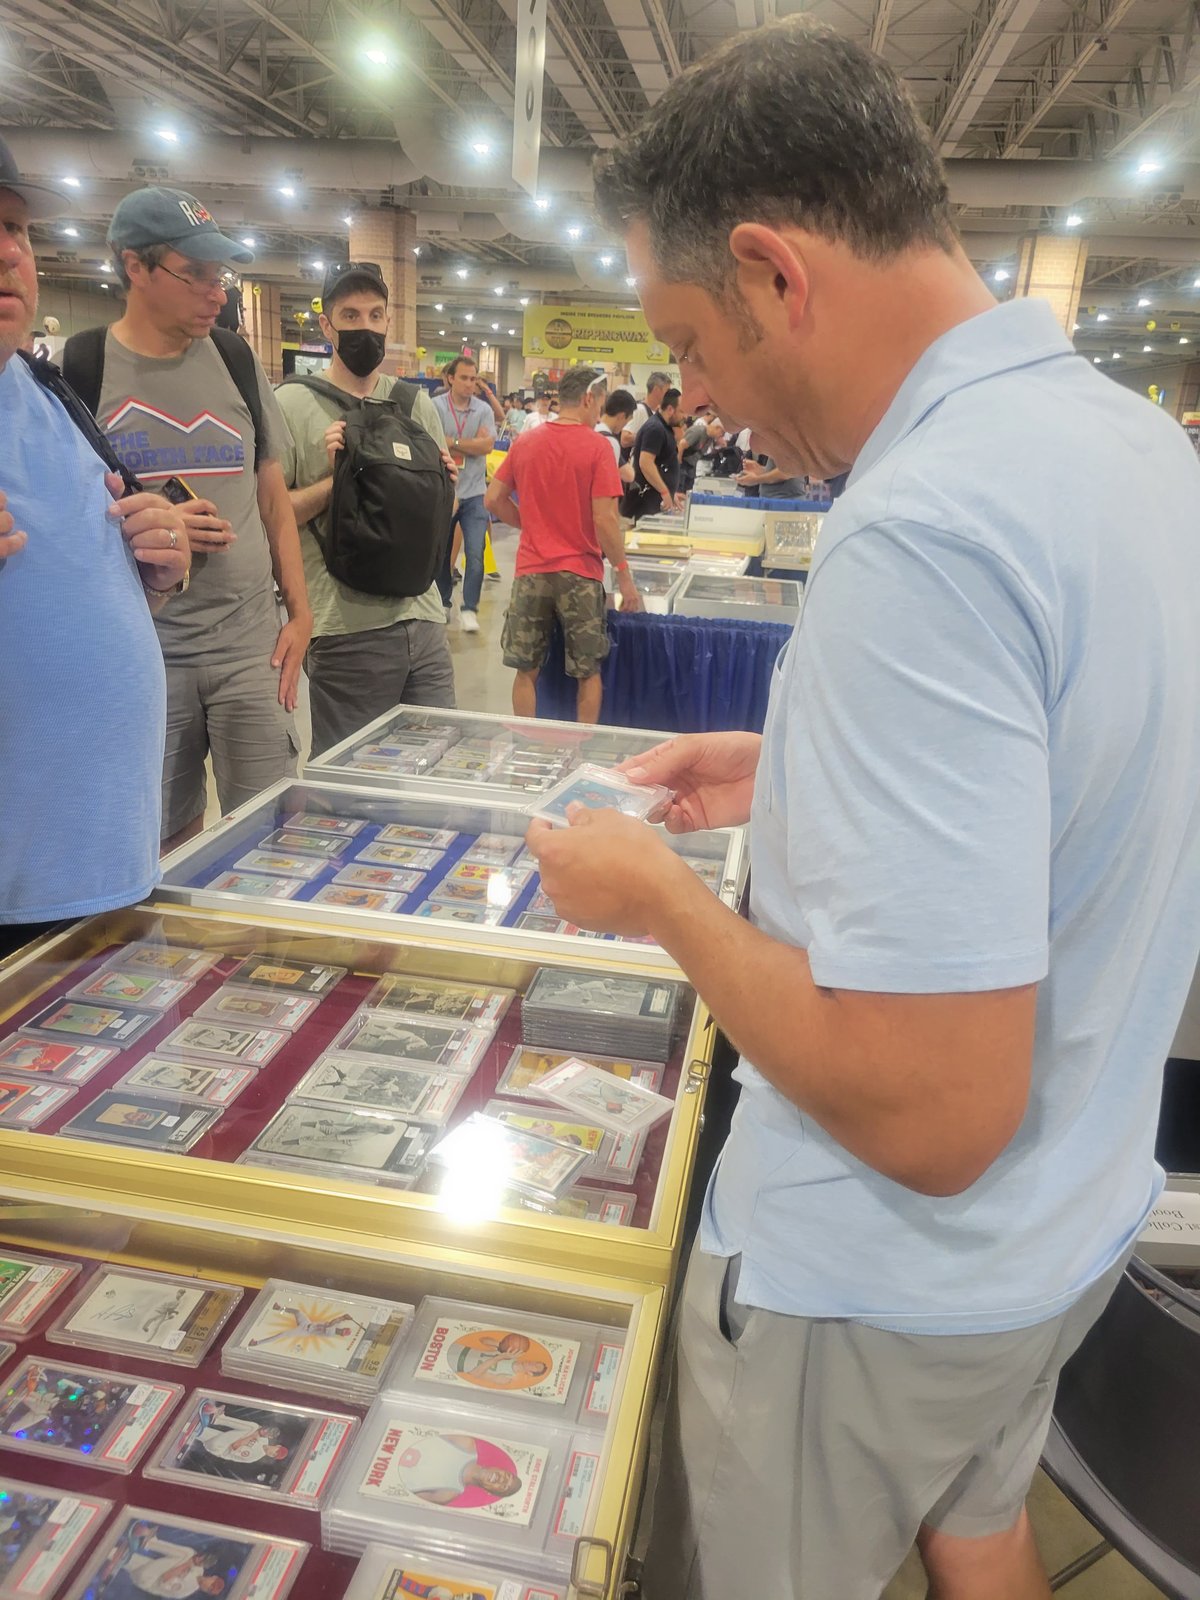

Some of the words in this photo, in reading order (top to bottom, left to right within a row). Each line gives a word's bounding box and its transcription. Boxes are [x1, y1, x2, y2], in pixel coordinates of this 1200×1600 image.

[573, 328, 649, 343] RIPPINGWAX
[107, 430, 149, 449] THE
[189, 443, 245, 464] FACE
[419, 1326, 450, 1372] BOSTON
[380, 1427, 404, 1456] NEW
[364, 1455, 391, 1487] YORK
